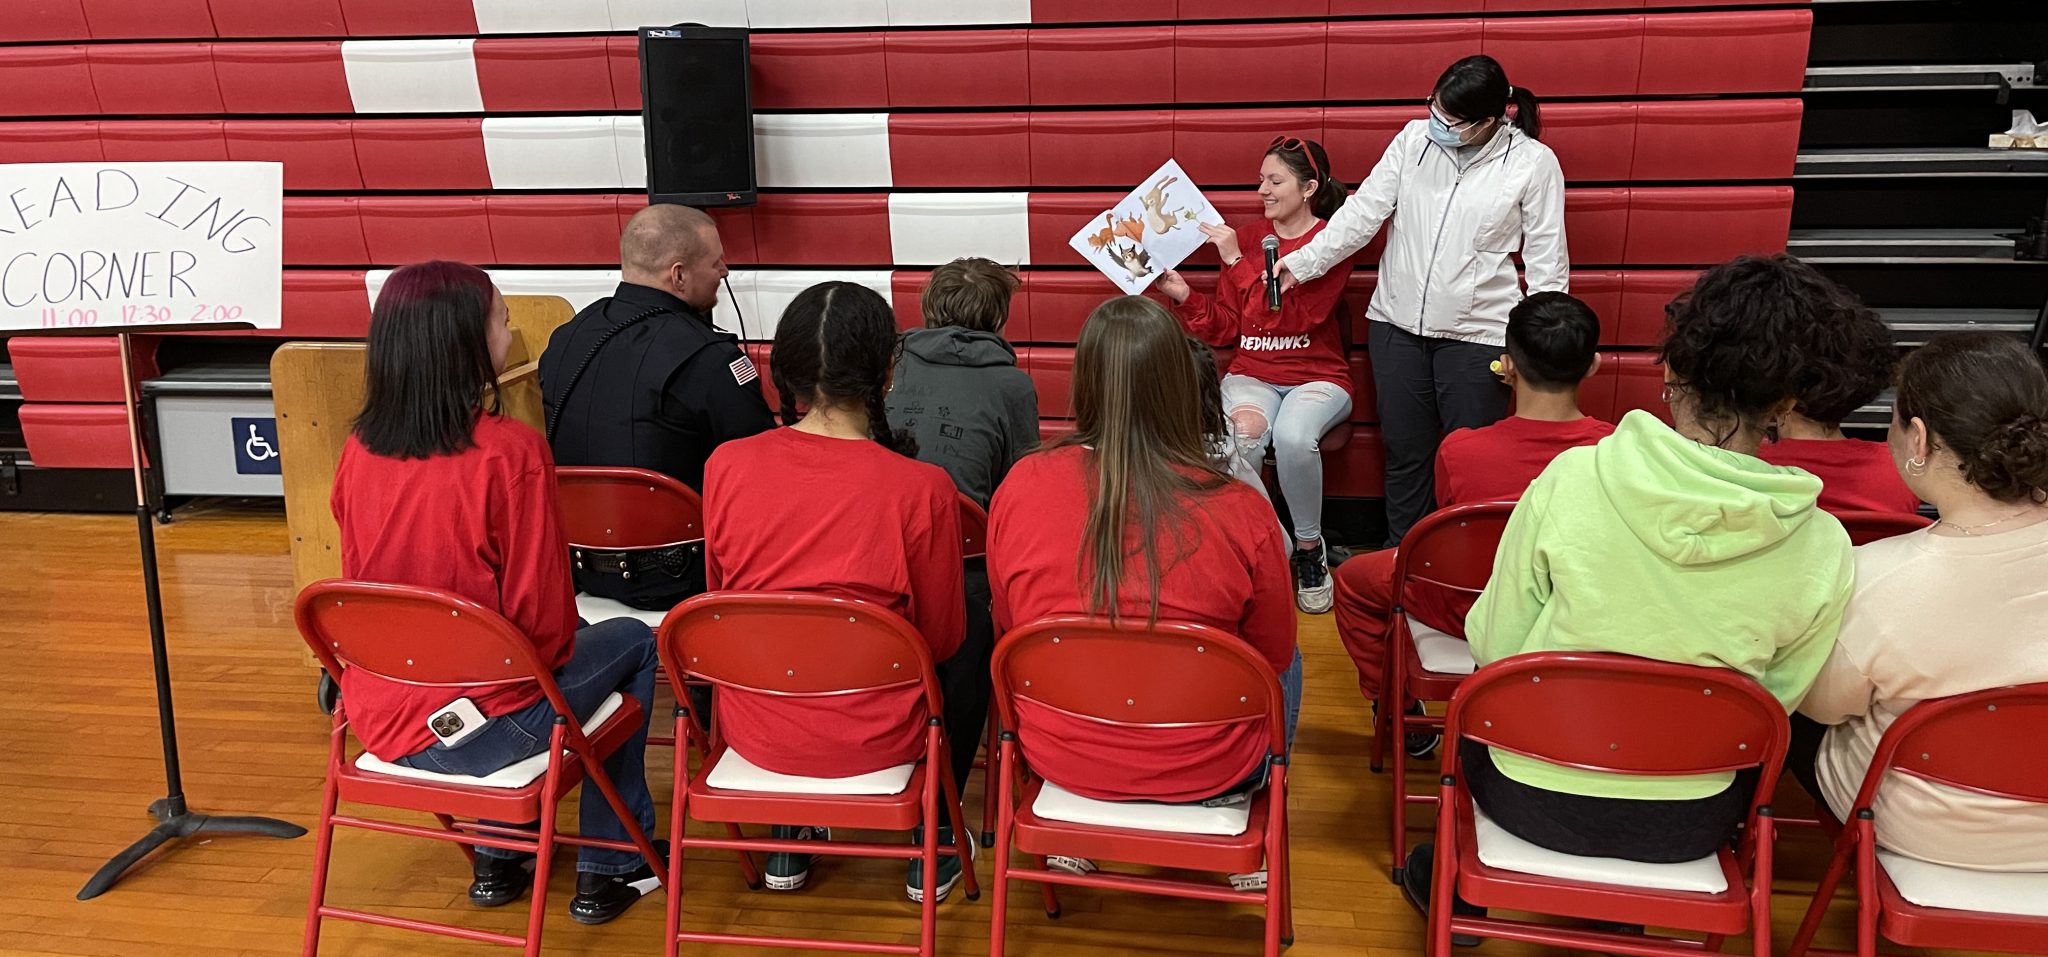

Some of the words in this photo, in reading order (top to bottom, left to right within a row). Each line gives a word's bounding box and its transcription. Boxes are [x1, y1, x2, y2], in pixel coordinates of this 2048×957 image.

[0, 169, 271, 254] EADING
[2, 250, 198, 307] CORNER
[41, 308, 98, 327] 11:00
[121, 304, 172, 324] 12:30
[1240, 334, 1311, 351] REDHAWKS
